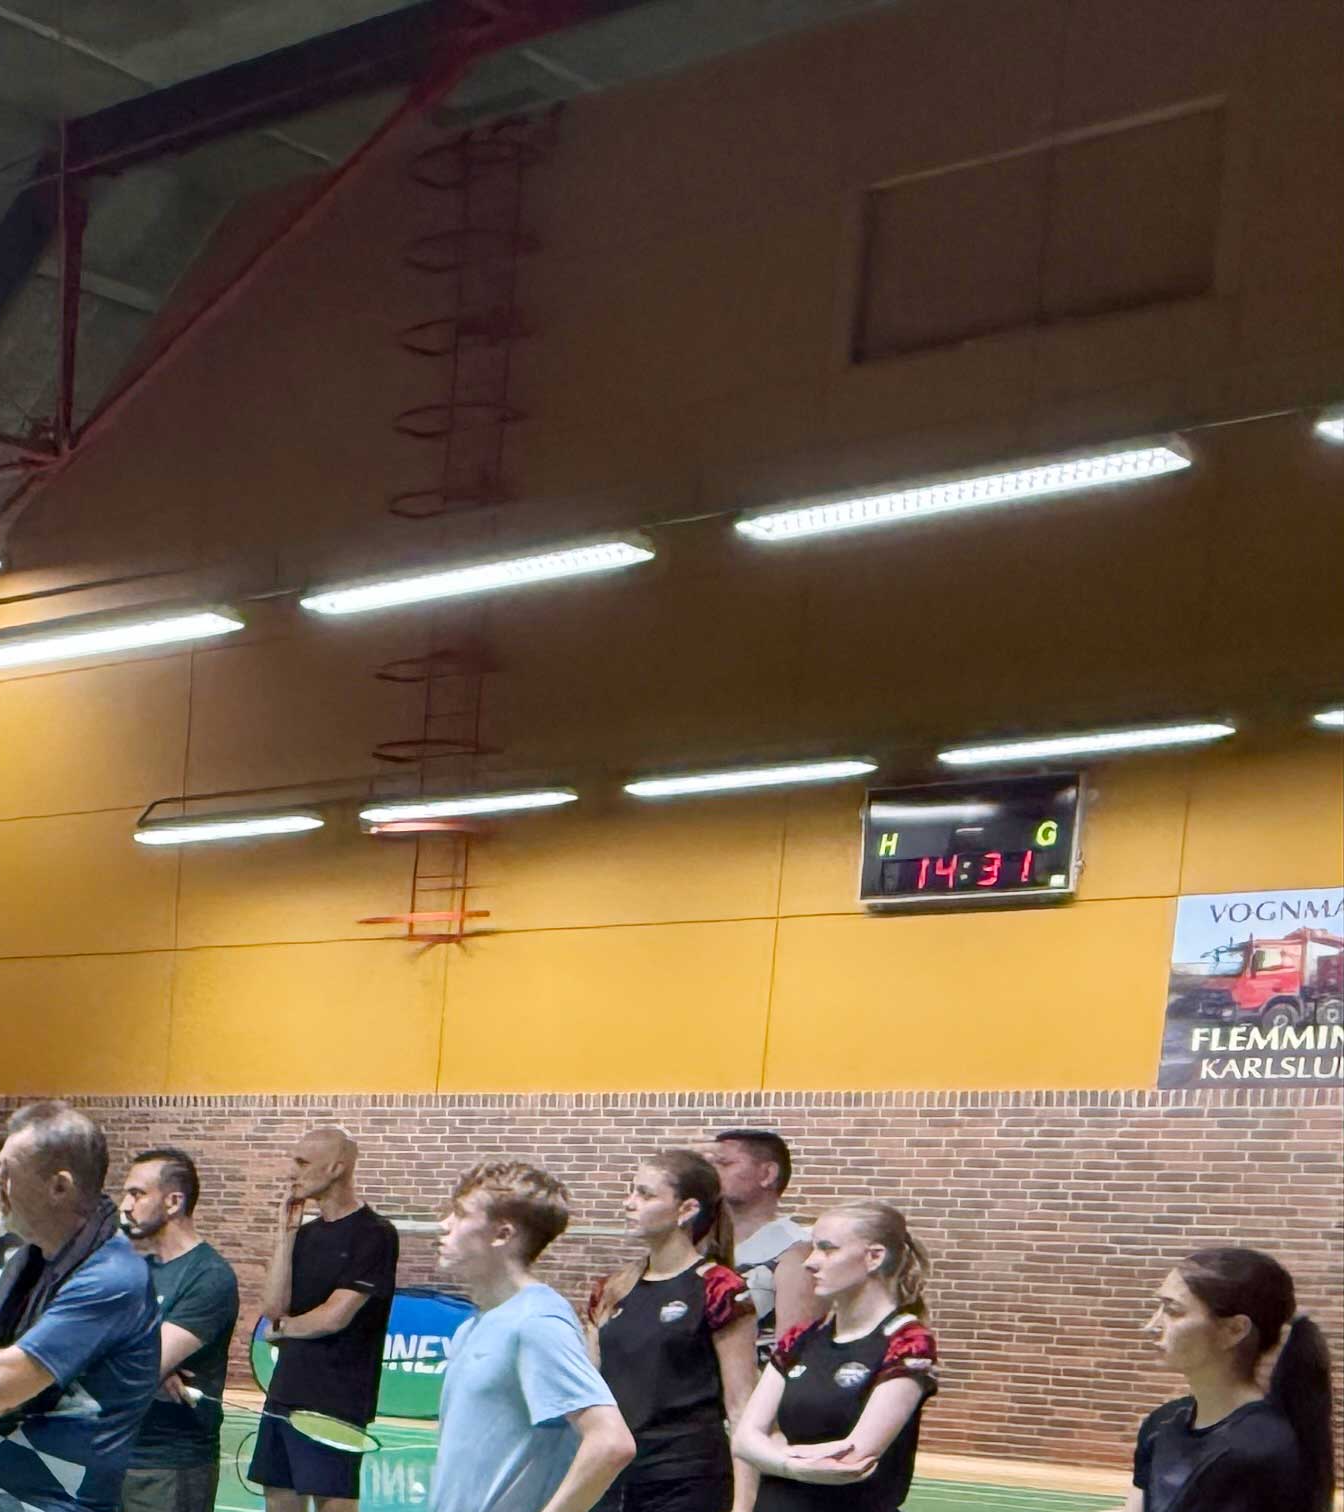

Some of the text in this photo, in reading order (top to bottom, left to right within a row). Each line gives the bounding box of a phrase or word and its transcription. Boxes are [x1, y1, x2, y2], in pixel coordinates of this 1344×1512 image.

[879, 832, 899, 857] H
[1036, 819, 1058, 847] G
[917, 850, 1032, 889] 14:31
[1199, 1056, 1344, 1081] KARLSLU
[382, 1333, 453, 1374] NE
